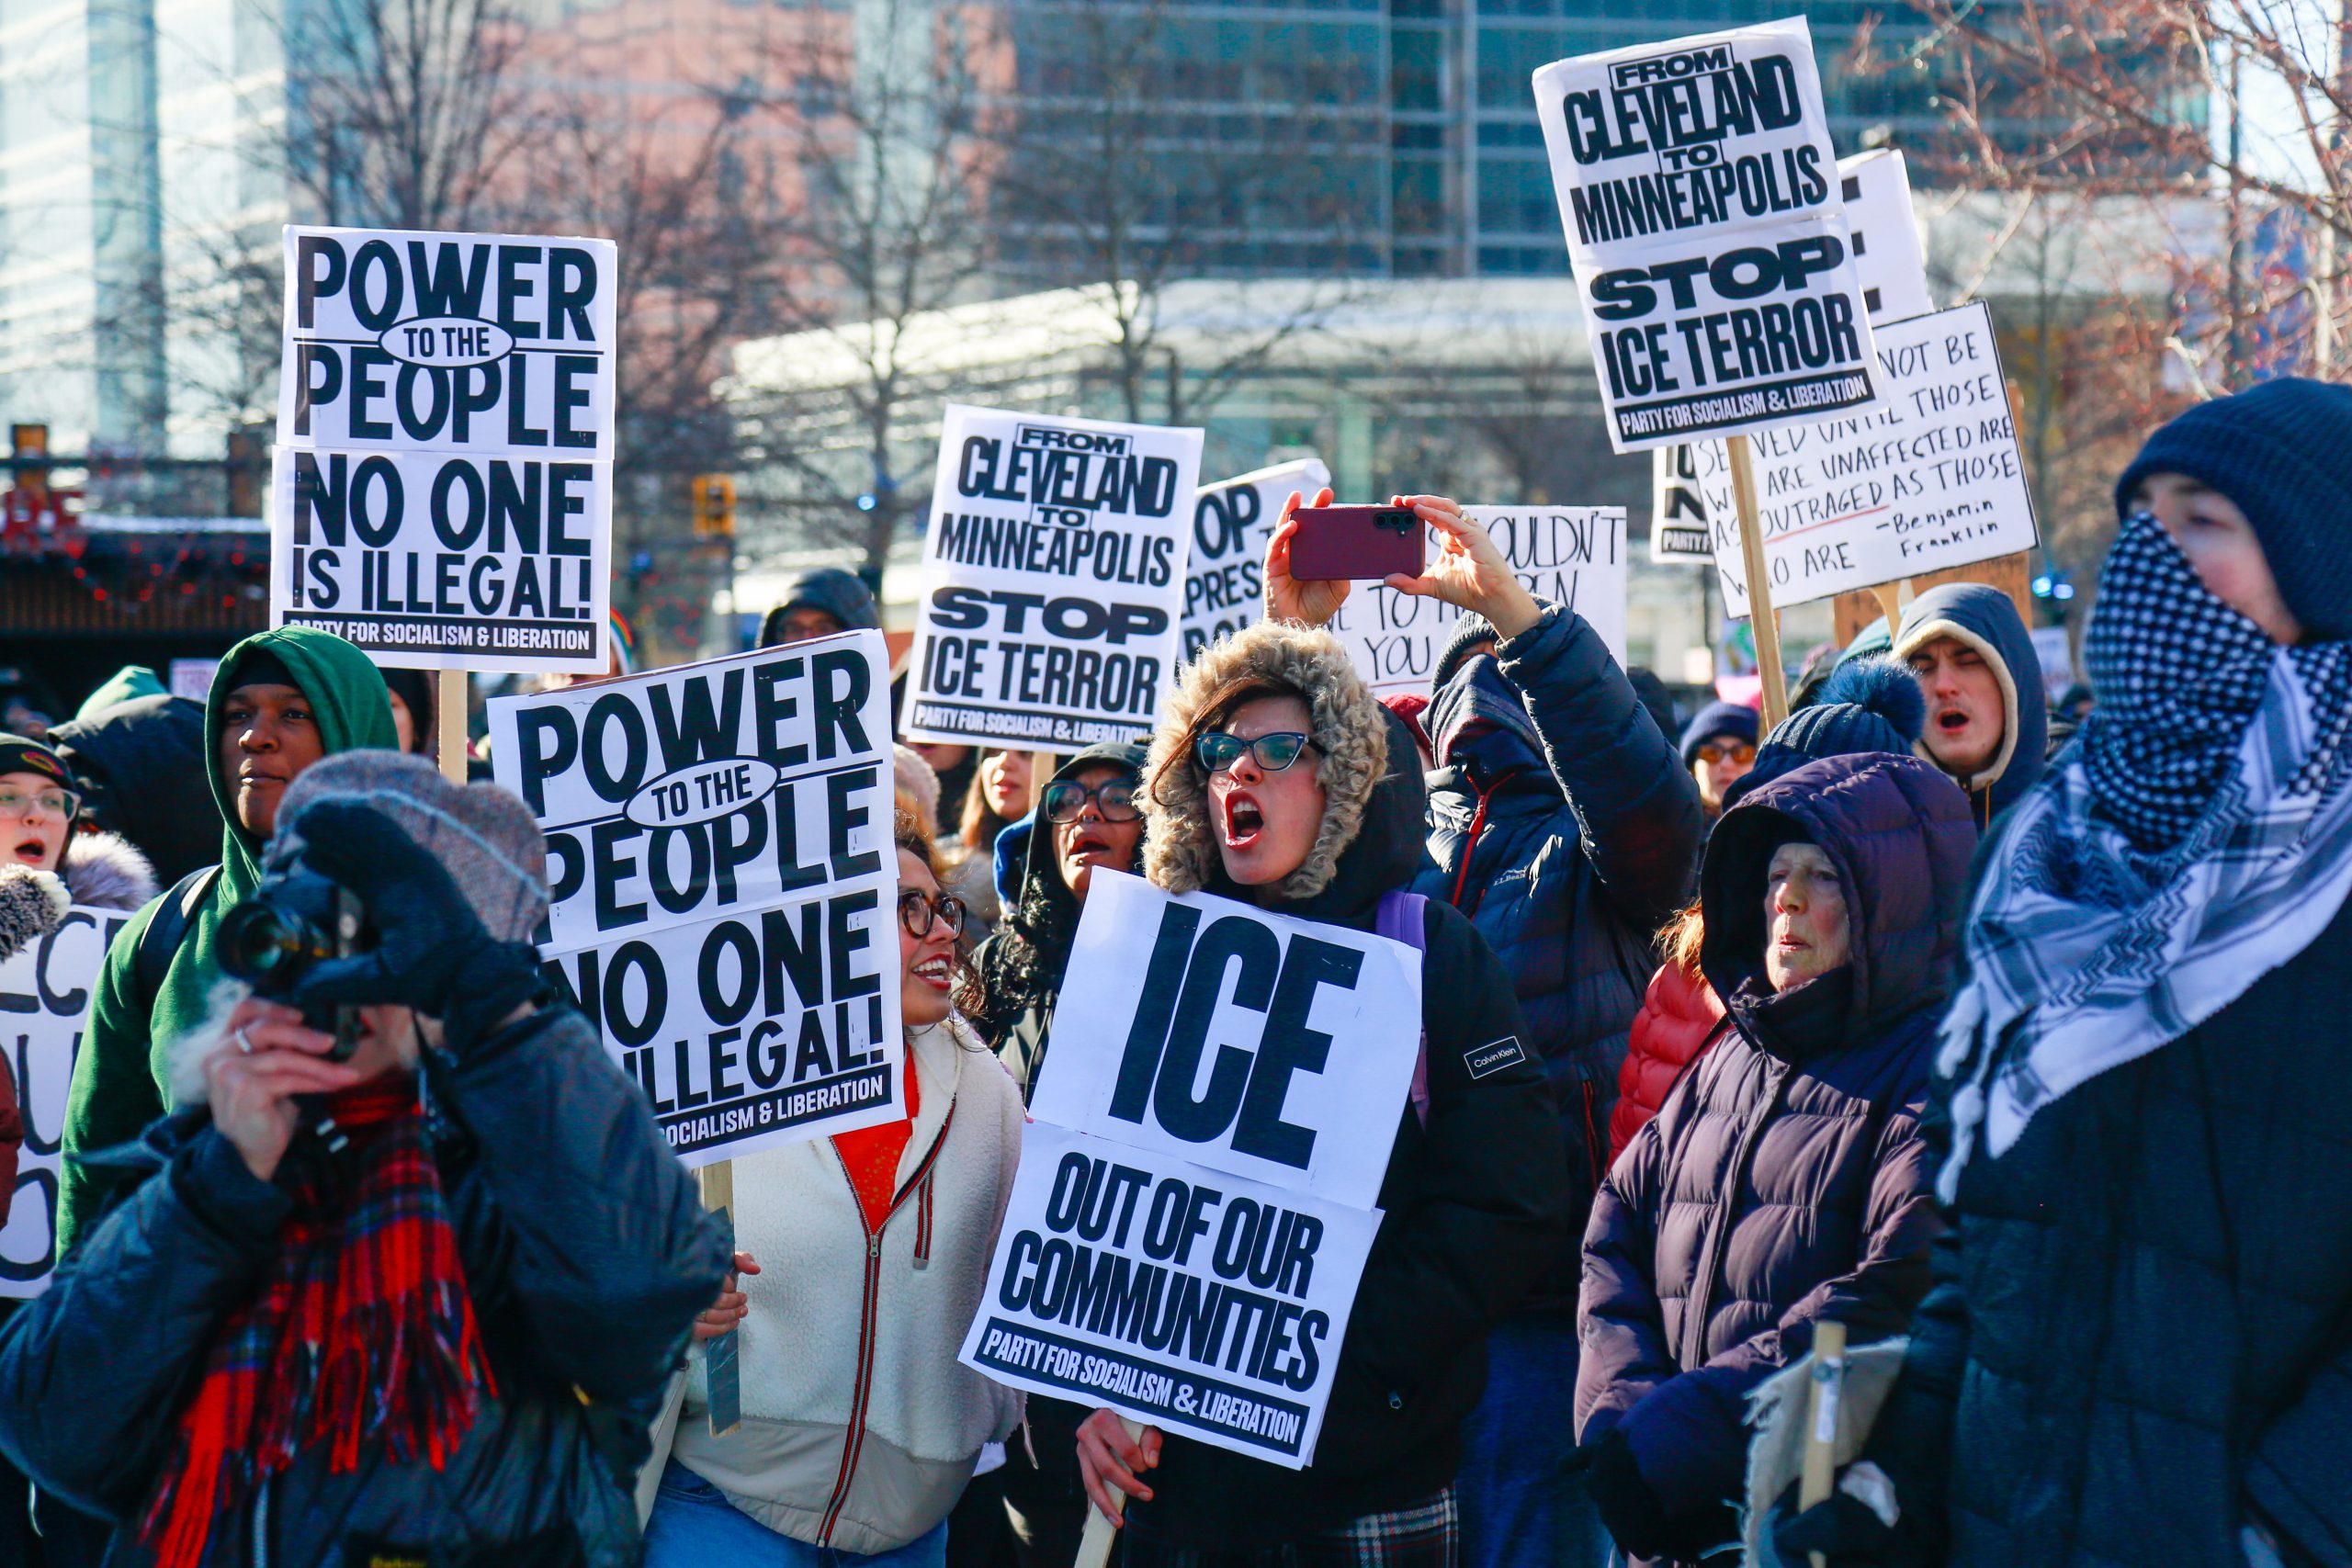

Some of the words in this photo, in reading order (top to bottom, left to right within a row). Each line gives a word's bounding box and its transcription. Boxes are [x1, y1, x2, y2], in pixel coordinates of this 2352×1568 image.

[1615, 47, 1729, 87] FROM
[1563, 54, 1802, 165] CLEVELAND
[1570, 143, 1828, 245] MINNEAPOLIS
[1663, 144, 1717, 171] TO
[298, 236, 597, 341] POWER
[1589, 234, 1844, 321] STOP
[404, 327, 434, 357] TO
[442, 327, 490, 356] THE
[1600, 322, 1679, 400] ICE
[1676, 292, 1861, 388] TERROR
[1945, 332, 1980, 366] BE
[294, 344, 598, 448] PEOPLE
[1620, 407, 1667, 435] PARTY
[1666, 402, 1692, 428] FOR
[1690, 390, 1765, 423] SOCIALISM
[1768, 389, 1787, 412] &
[1787, 375, 1868, 410] LIBERATION
[1699, 428, 1806, 477] SEVED
[1909, 374, 1995, 418] THOSE
[957, 435, 1178, 518] CLEVELAND
[1021, 428, 1126, 455] FROM
[1768, 464, 1813, 497] ARE
[1821, 425, 1972, 481] UNAFFECTED
[1980, 415, 2015, 445] ARE
[294, 453, 404, 548] NO
[431, 458, 593, 556] ONE
[1036, 506, 1086, 527] TO
[1192, 483, 1261, 562] OP
[1760, 482, 1882, 539] OUTRAGED
[1894, 469, 1924, 500] AS
[1929, 449, 2018, 491] THOSE
[934, 512, 1174, 587] MINNEAPOLIS
[1804, 542, 1856, 577] ARE
[1900, 521, 1998, 557] Franklin
[292, 547, 341, 609] IS
[362, 550, 591, 619] ILLEGAL!
[929, 586, 1170, 645] STOP
[1367, 584, 1419, 630] TO
[347, 623, 379, 642] FOR
[383, 624, 473, 646] SOCIALISM
[476, 628, 490, 646] &
[493, 628, 589, 650] LIBERATION
[920, 636, 994, 698] ICE
[998, 641, 1159, 716] TERROR
[1364, 636, 1430, 681] YOU
[515, 649, 873, 818] POWER
[916, 705, 958, 730] PARTY
[957, 710, 986, 732] FOR
[985, 713, 1053, 739] SOCIALISM
[1055, 719, 1072, 740] &
[650, 784, 688, 821] TO
[700, 764, 752, 807] THE
[532, 767, 882, 945] PEOPLE
[540, 940, 668, 1048] NO
[698, 888, 881, 1027] ONE
[624, 995, 884, 1114] ILLEGAL!
[1108, 901, 1365, 1171] ICE
[1474, 1055, 1499, 1067] Calvin
[1498, 1047, 1516, 1058] Klein
[660, 1104, 754, 1148] OCIALISM
[759, 1101, 773, 1125] &
[775, 1075, 883, 1119] LIBERATION
[1046, 1151, 1154, 1246] OUT
[1143, 1178, 1223, 1266] OF
[1212, 1197, 1324, 1299] OUR
[998, 1229, 1330, 1392] COMMUNITIES
[983, 1329, 1046, 1370] PARTY
[1045, 1342, 1081, 1381] FOR
[1080, 1352, 1172, 1408] SOCIALISM
[1173, 1384, 1199, 1416] &
[1199, 1392, 1302, 1445] LIBERATION
